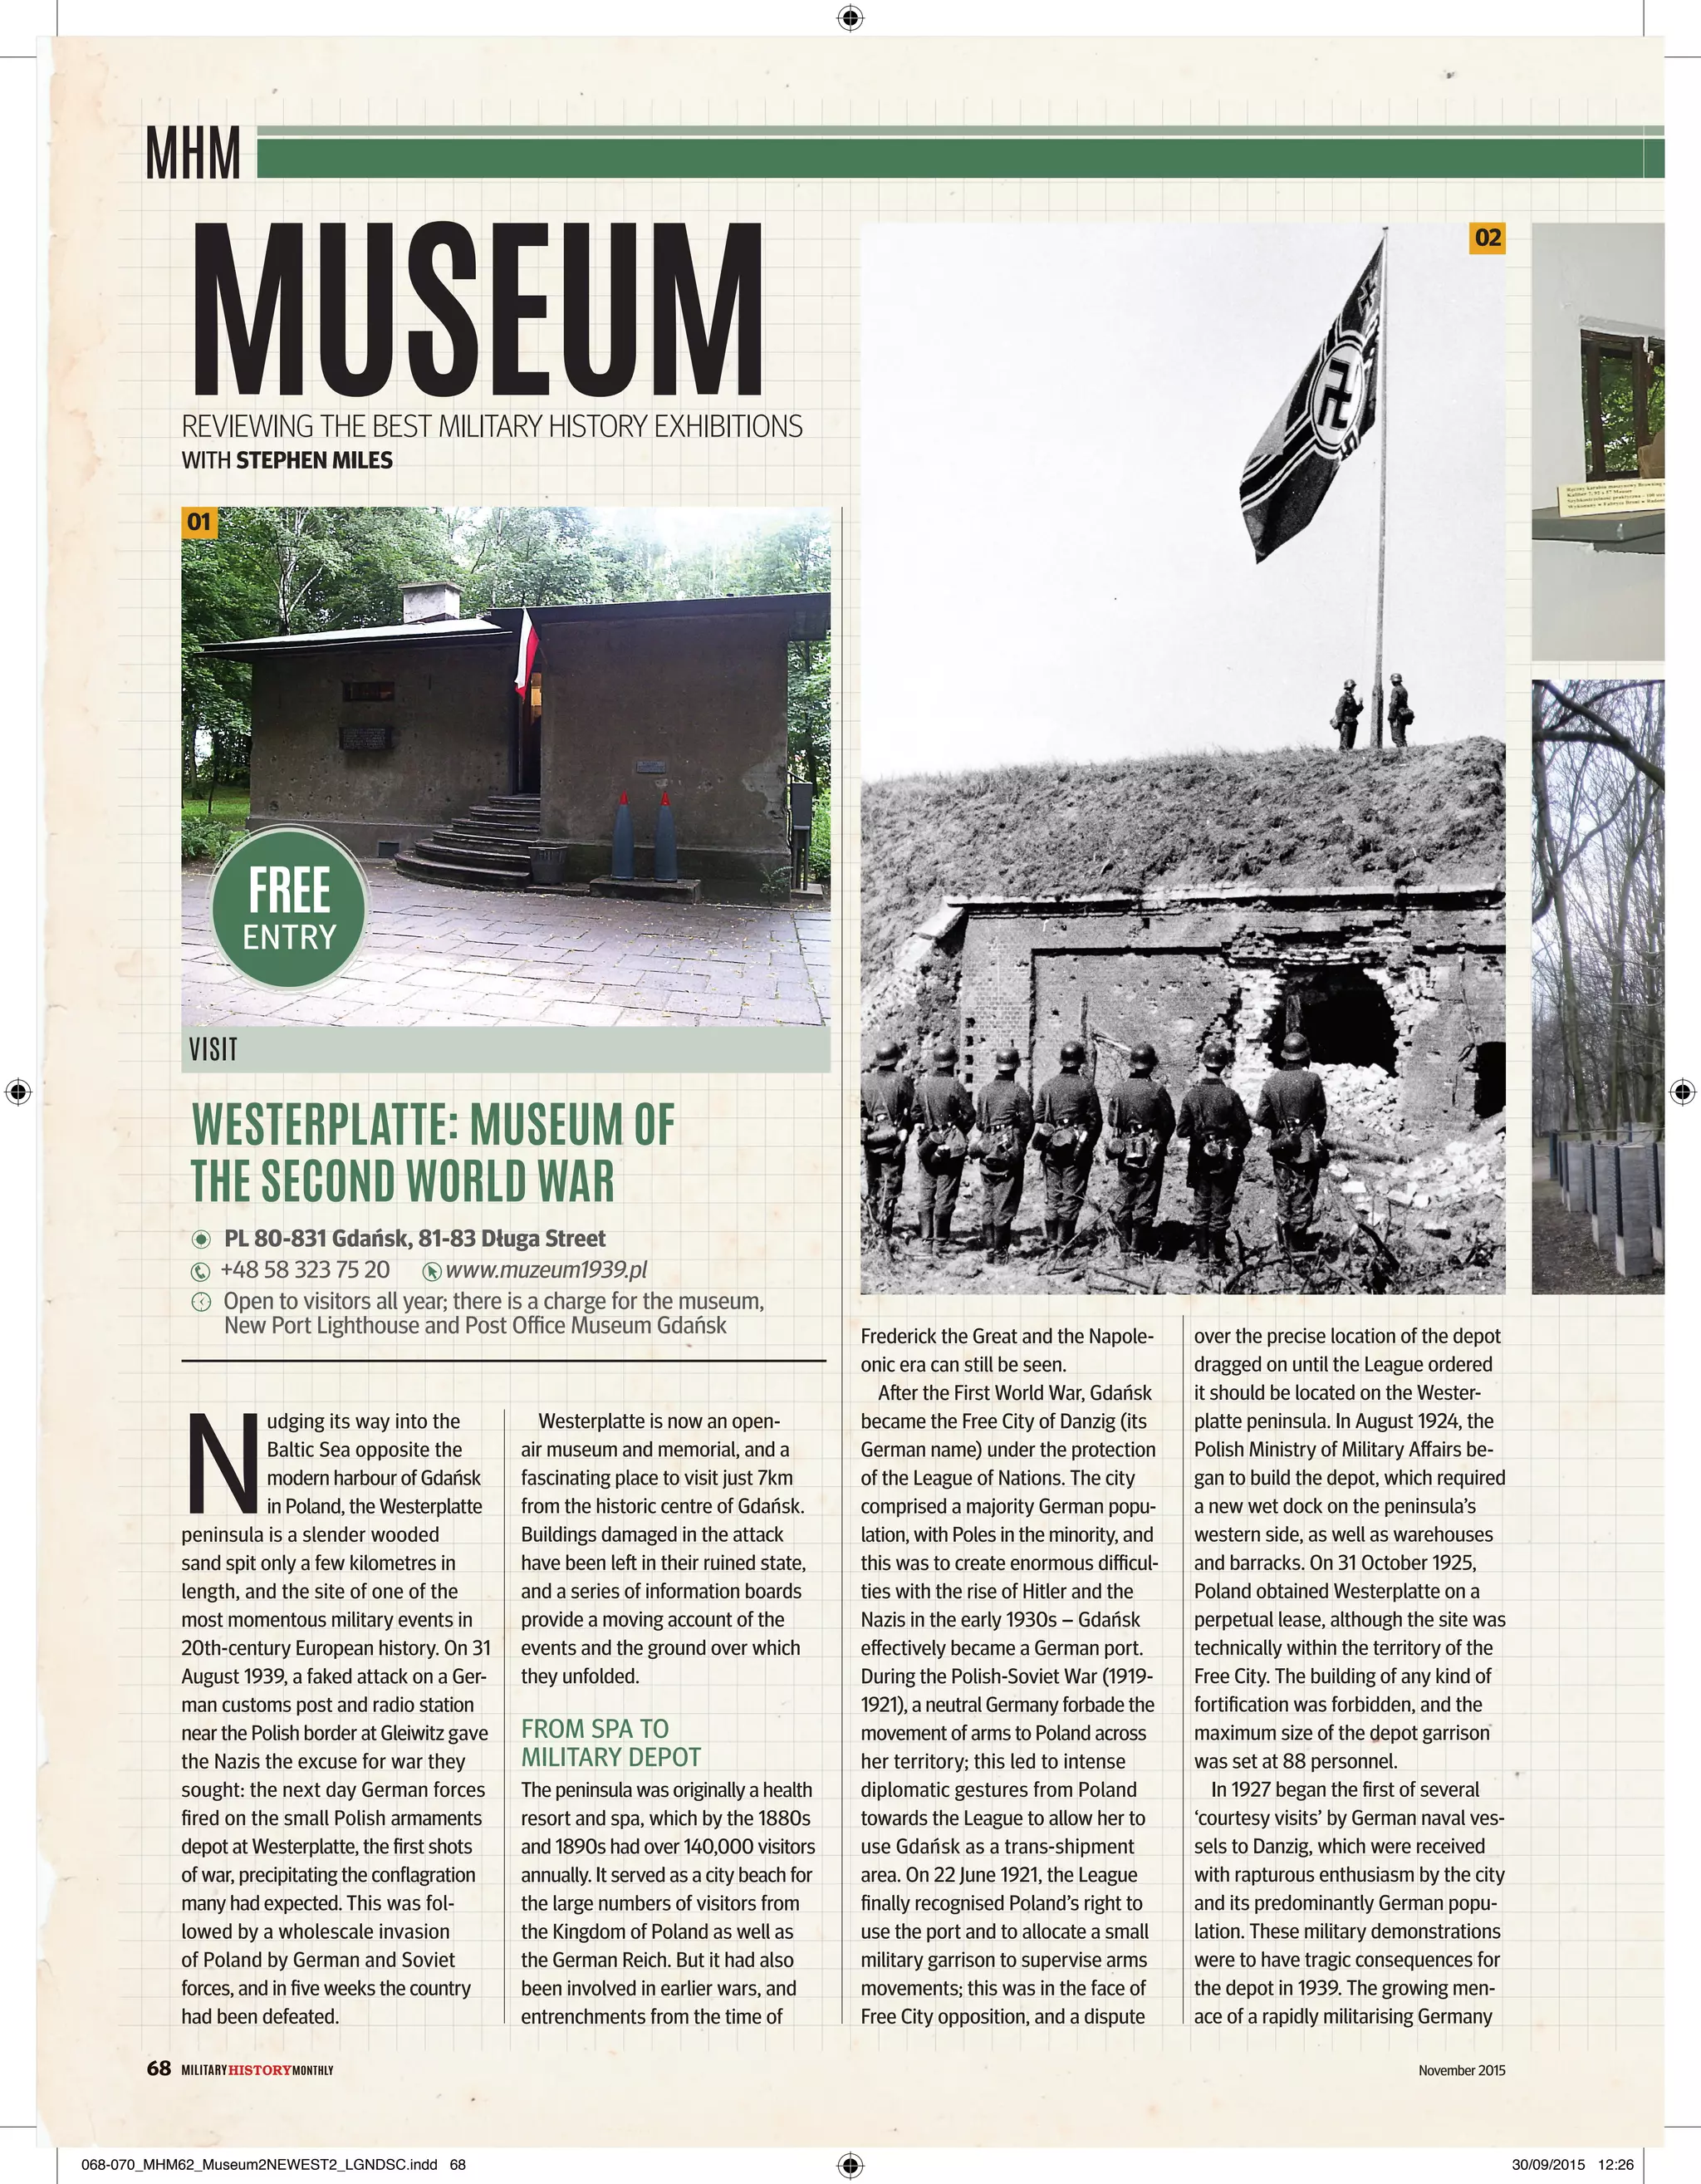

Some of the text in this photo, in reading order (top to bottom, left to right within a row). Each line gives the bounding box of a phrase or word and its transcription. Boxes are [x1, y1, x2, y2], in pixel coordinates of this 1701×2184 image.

[146, 125, 240, 179] MHM
[1475, 228, 1502, 248] 02
[194, 220, 762, 398] MUSEUM
[183, 414, 803, 438] REVIEWING THE BEST MILITARY HISTORY EXHIBITIONS
[181, 450, 394, 469] WITH STEPHEN MILES
[187, 512, 210, 532] 01
[250, 866, 331, 913] FREE
[244, 924, 337, 950] ENTRY
[189, 1036, 238, 1062] VISIT
[192, 1102, 674, 1146] WESTERPLATTE: MUSEUM OF
[190, 1158, 614, 1203] THE SECOND WORLD WAR
[225, 1228, 606, 1252] PL 80-831 Gdańsk, 81-83 Długa Street
[221, 1259, 390, 1278] +48 58 323 75 20
[446, 1259, 648, 1283] www.muzeum1939.pl
[223, 1290, 764, 1314] Open to visitors all year; there is a charge for the museum,
[225, 1315, 728, 1338] New Port Lighthouse and Post Office Museum Gdańsk
[1194, 1327, 1502, 1347] over the precise location of the depot
[861, 1327, 1154, 1348] Frederick the Great and the Napole-
[330, 1412, 350, 1430] its
[355, 1416, 390, 1433] way
[395, 1412, 428, 1430] into
[432, 1412, 460, 1430] the
[538, 1412, 781, 1433] Westerplatte is now an open-
[267, 1440, 463, 1461] Baltic Sea opposite the
[267, 1469, 482, 1486] modern harbour of Gdańsk
[267, 1497, 483, 1518] in Poland, the Westerplatte
[522, 1718, 669, 1739] FROM SPA TO
[522, 1746, 702, 1767] MILITARY DEPOT
[521, 1781, 812, 1802] The peninsula was originally a health
[1212, 1780, 1480, 1802] In 1927 began the first of several
[861, 2007, 1145, 2029] Free City opposition, and a dispute
[1194, 2007, 1493, 2029] ace of a rapidly militarising Germany
[146, 2059, 172, 2077] 68
[1419, 2064, 1506, 2077] November 2015
